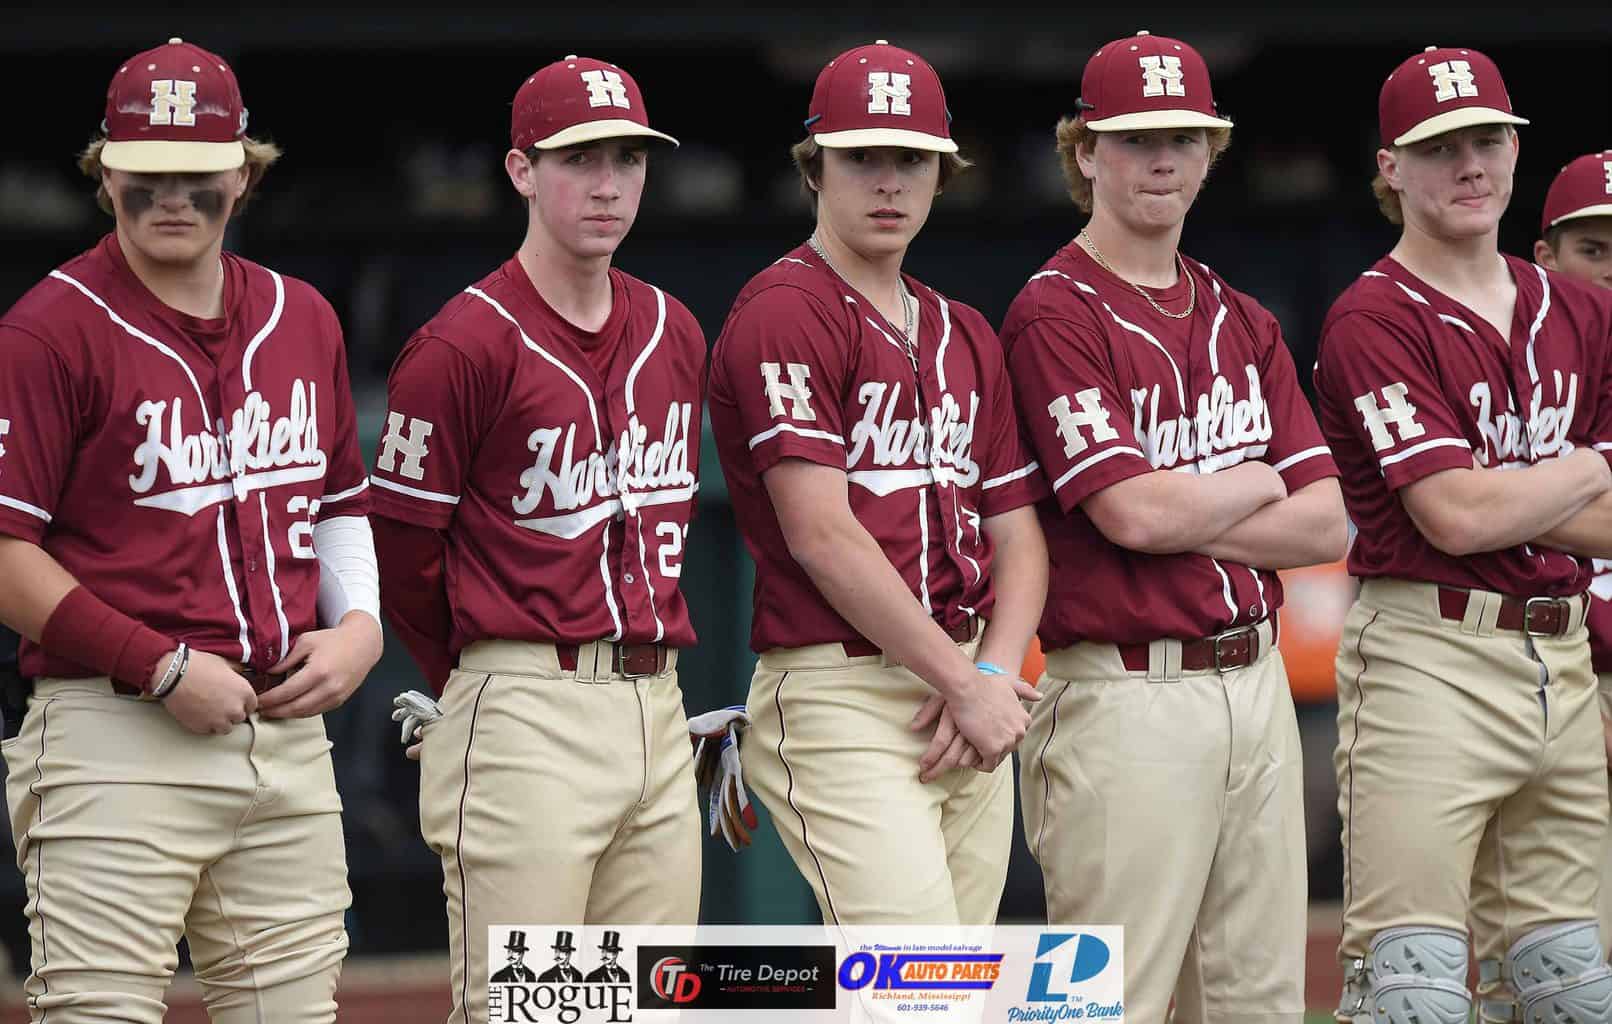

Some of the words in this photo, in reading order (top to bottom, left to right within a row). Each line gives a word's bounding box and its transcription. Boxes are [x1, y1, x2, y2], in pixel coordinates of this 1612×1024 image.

[149, 79, 197, 126] H
[580, 69, 631, 109] H
[867, 71, 912, 116] H
[1138, 55, 1187, 97] H
[1428, 60, 1478, 103] H
[760, 362, 816, 421] H
[1354, 381, 1425, 452] H
[377, 411, 433, 481] H
[1048, 387, 1120, 460] H
[287, 496, 321, 559] 2
[656, 522, 690, 578] 2
